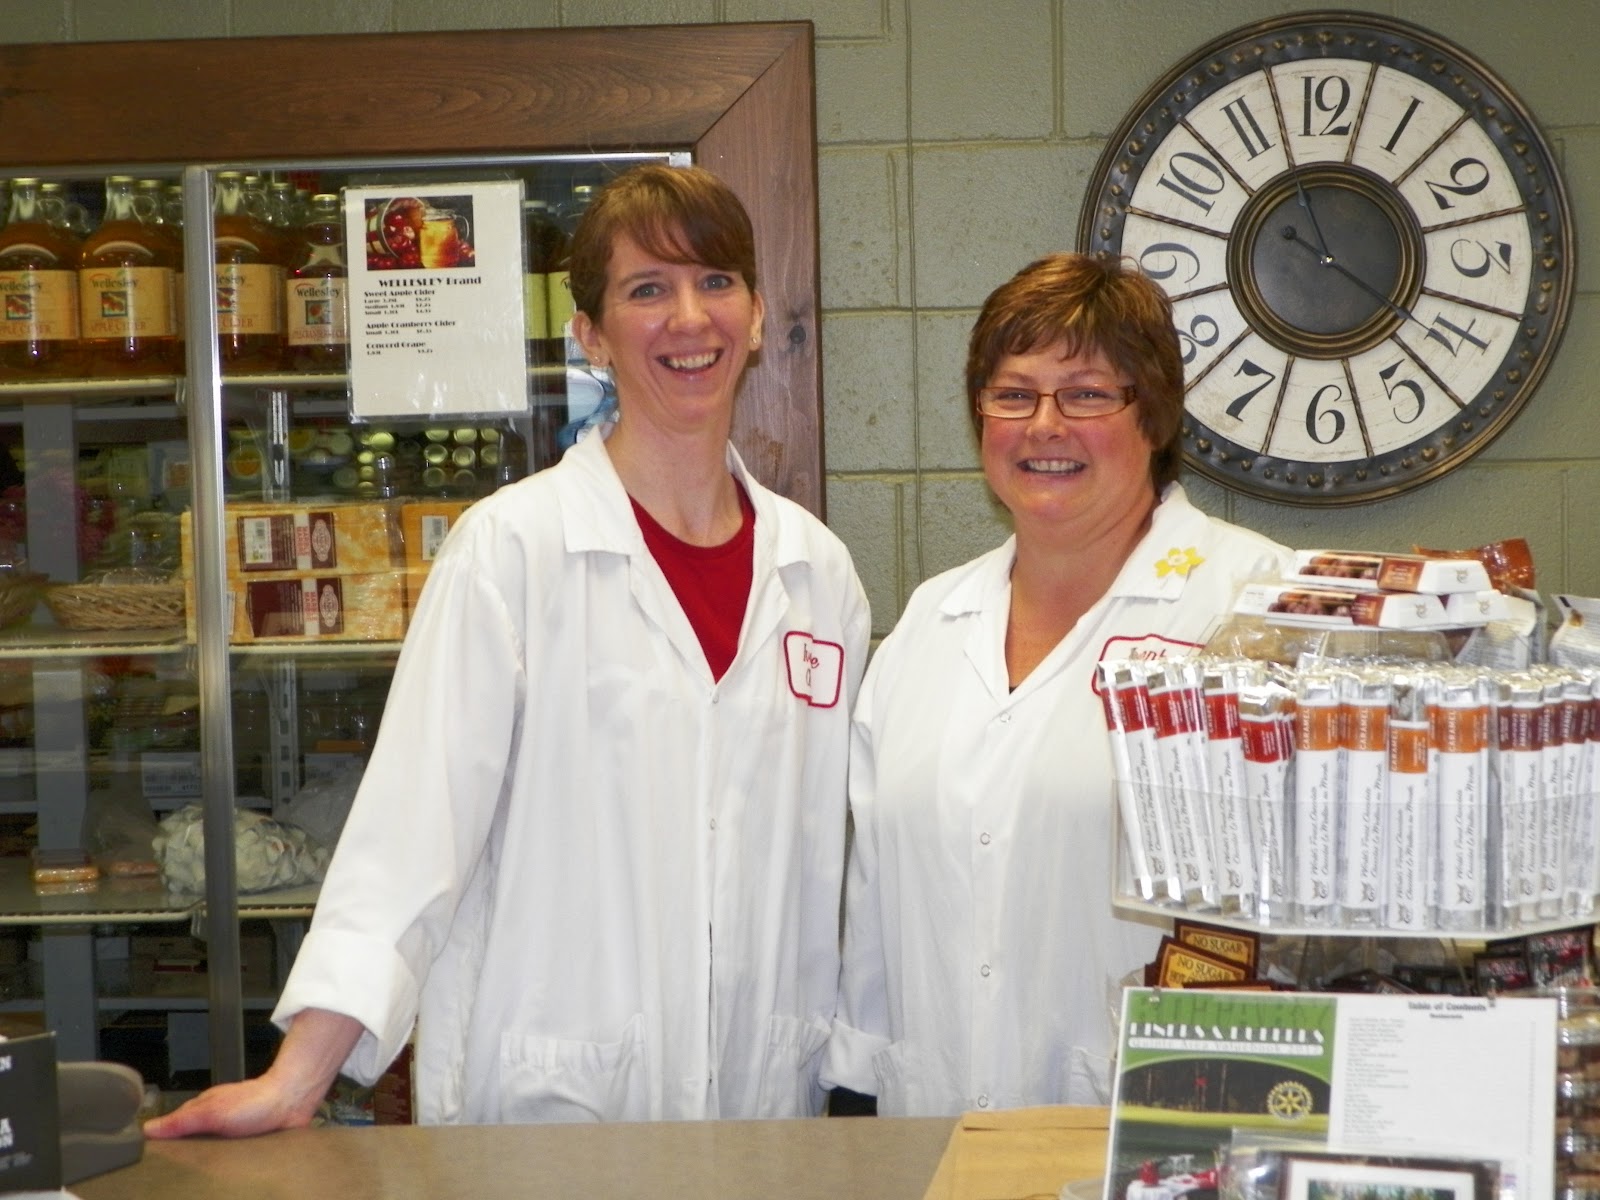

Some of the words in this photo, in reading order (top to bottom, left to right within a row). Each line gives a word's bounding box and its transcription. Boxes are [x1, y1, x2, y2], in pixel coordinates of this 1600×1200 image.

[1220, 96, 1275, 161] 11
[1298, 75, 1352, 137] 12
[1380, 96, 1424, 155] 1
[1157, 152, 1225, 217] 10
[1425, 157, 1490, 210] 2
[1139, 242, 1200, 283] 9
[1450, 239, 1511, 278] 3
[1178, 314, 1219, 365] 8
[1425, 312, 1491, 357] 4
[1225, 358, 1275, 422] 7
[1305, 384, 1345, 444] 6
[1379, 359, 1425, 424] 5
[1360, 708, 1368, 749] CARAMEL
